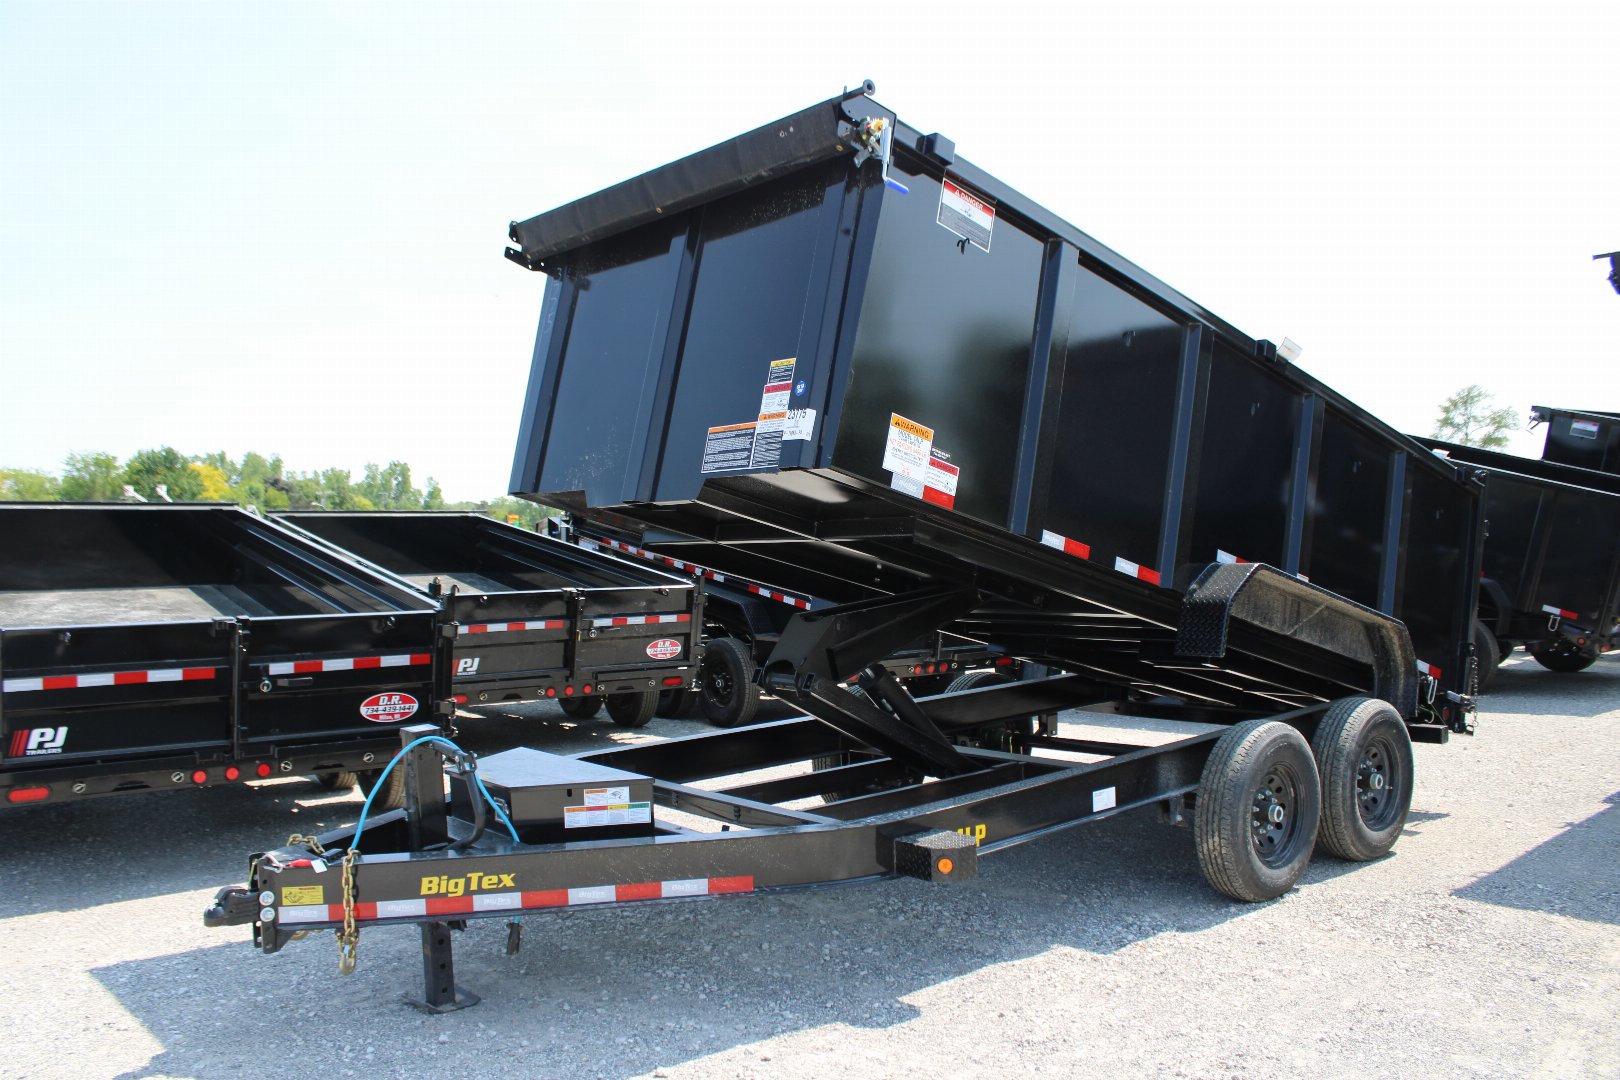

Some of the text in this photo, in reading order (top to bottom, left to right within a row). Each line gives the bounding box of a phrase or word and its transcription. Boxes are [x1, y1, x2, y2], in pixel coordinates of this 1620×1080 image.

[961, 192, 984, 211] DANGER
[900, 420, 929, 439] WARNING
[457, 657, 480, 673] PJ
[379, 695, 403, 706] D.R.
[26, 726, 69, 750] PJ
